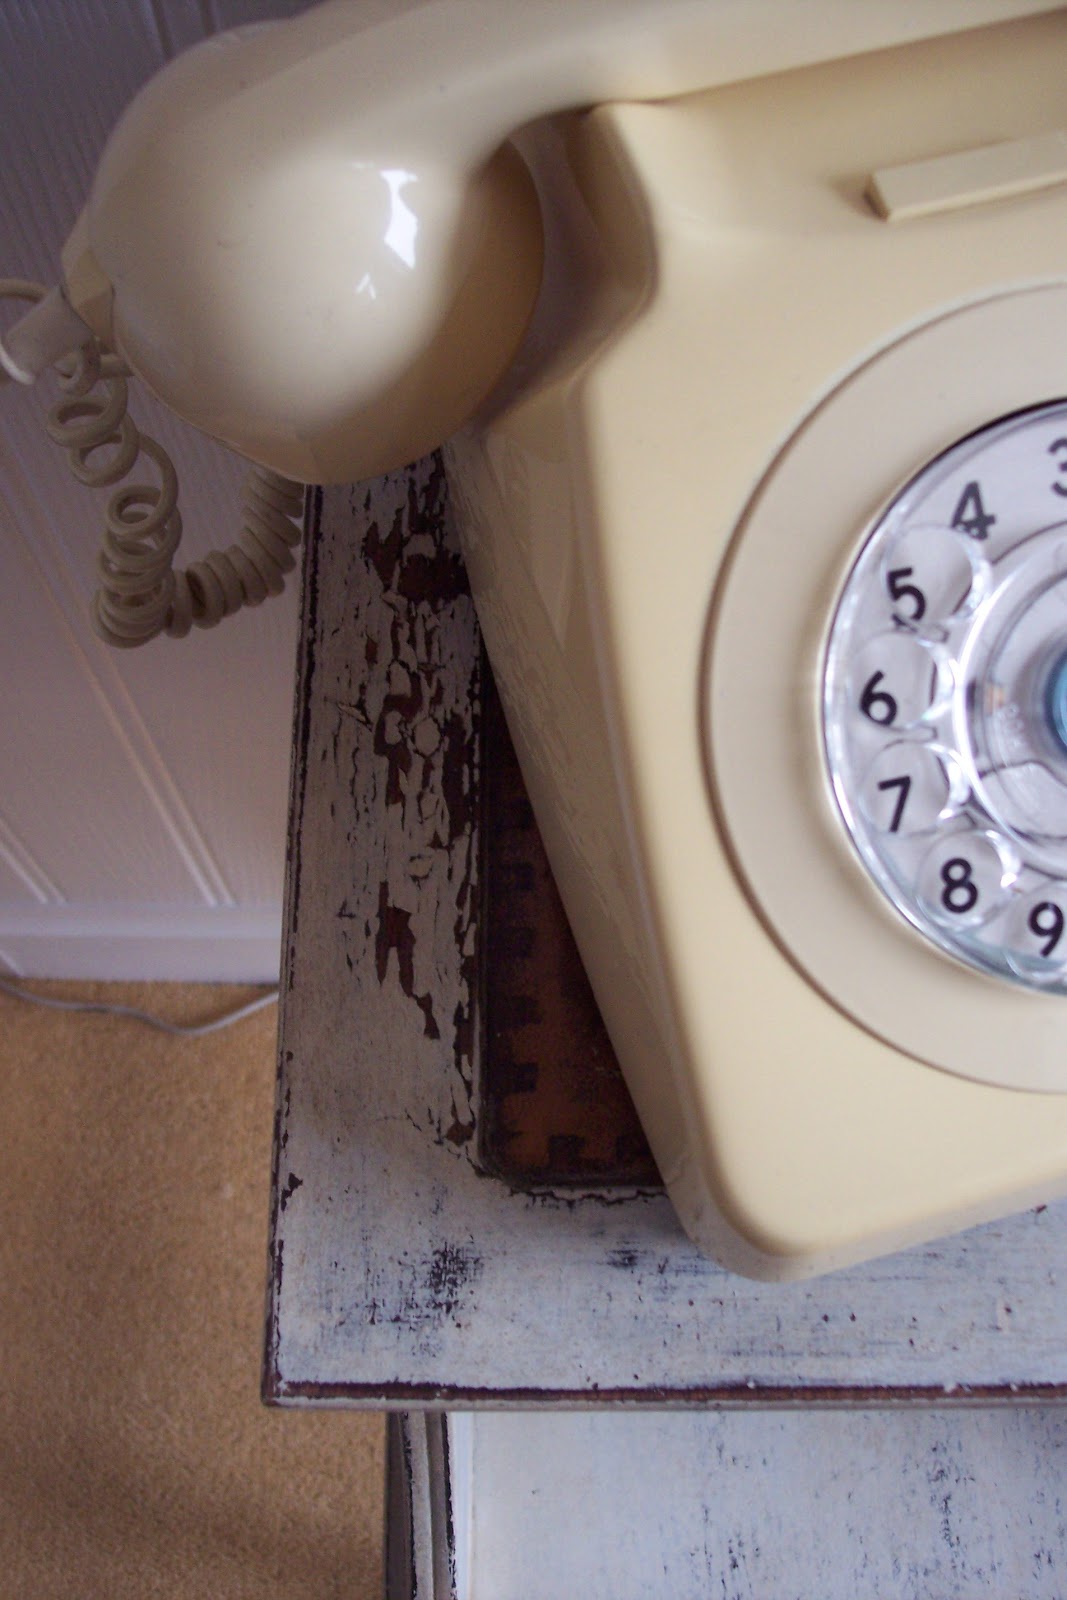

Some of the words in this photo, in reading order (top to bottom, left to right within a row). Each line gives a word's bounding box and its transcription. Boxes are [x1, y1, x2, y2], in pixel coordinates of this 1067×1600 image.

[951, 482, 995, 541] 4
[887, 567, 926, 630] 5
[860, 670, 897, 726] 6
[878, 776, 911, 833] 7
[941, 858, 978, 914] 8
[1028, 902, 1064, 958] 9
